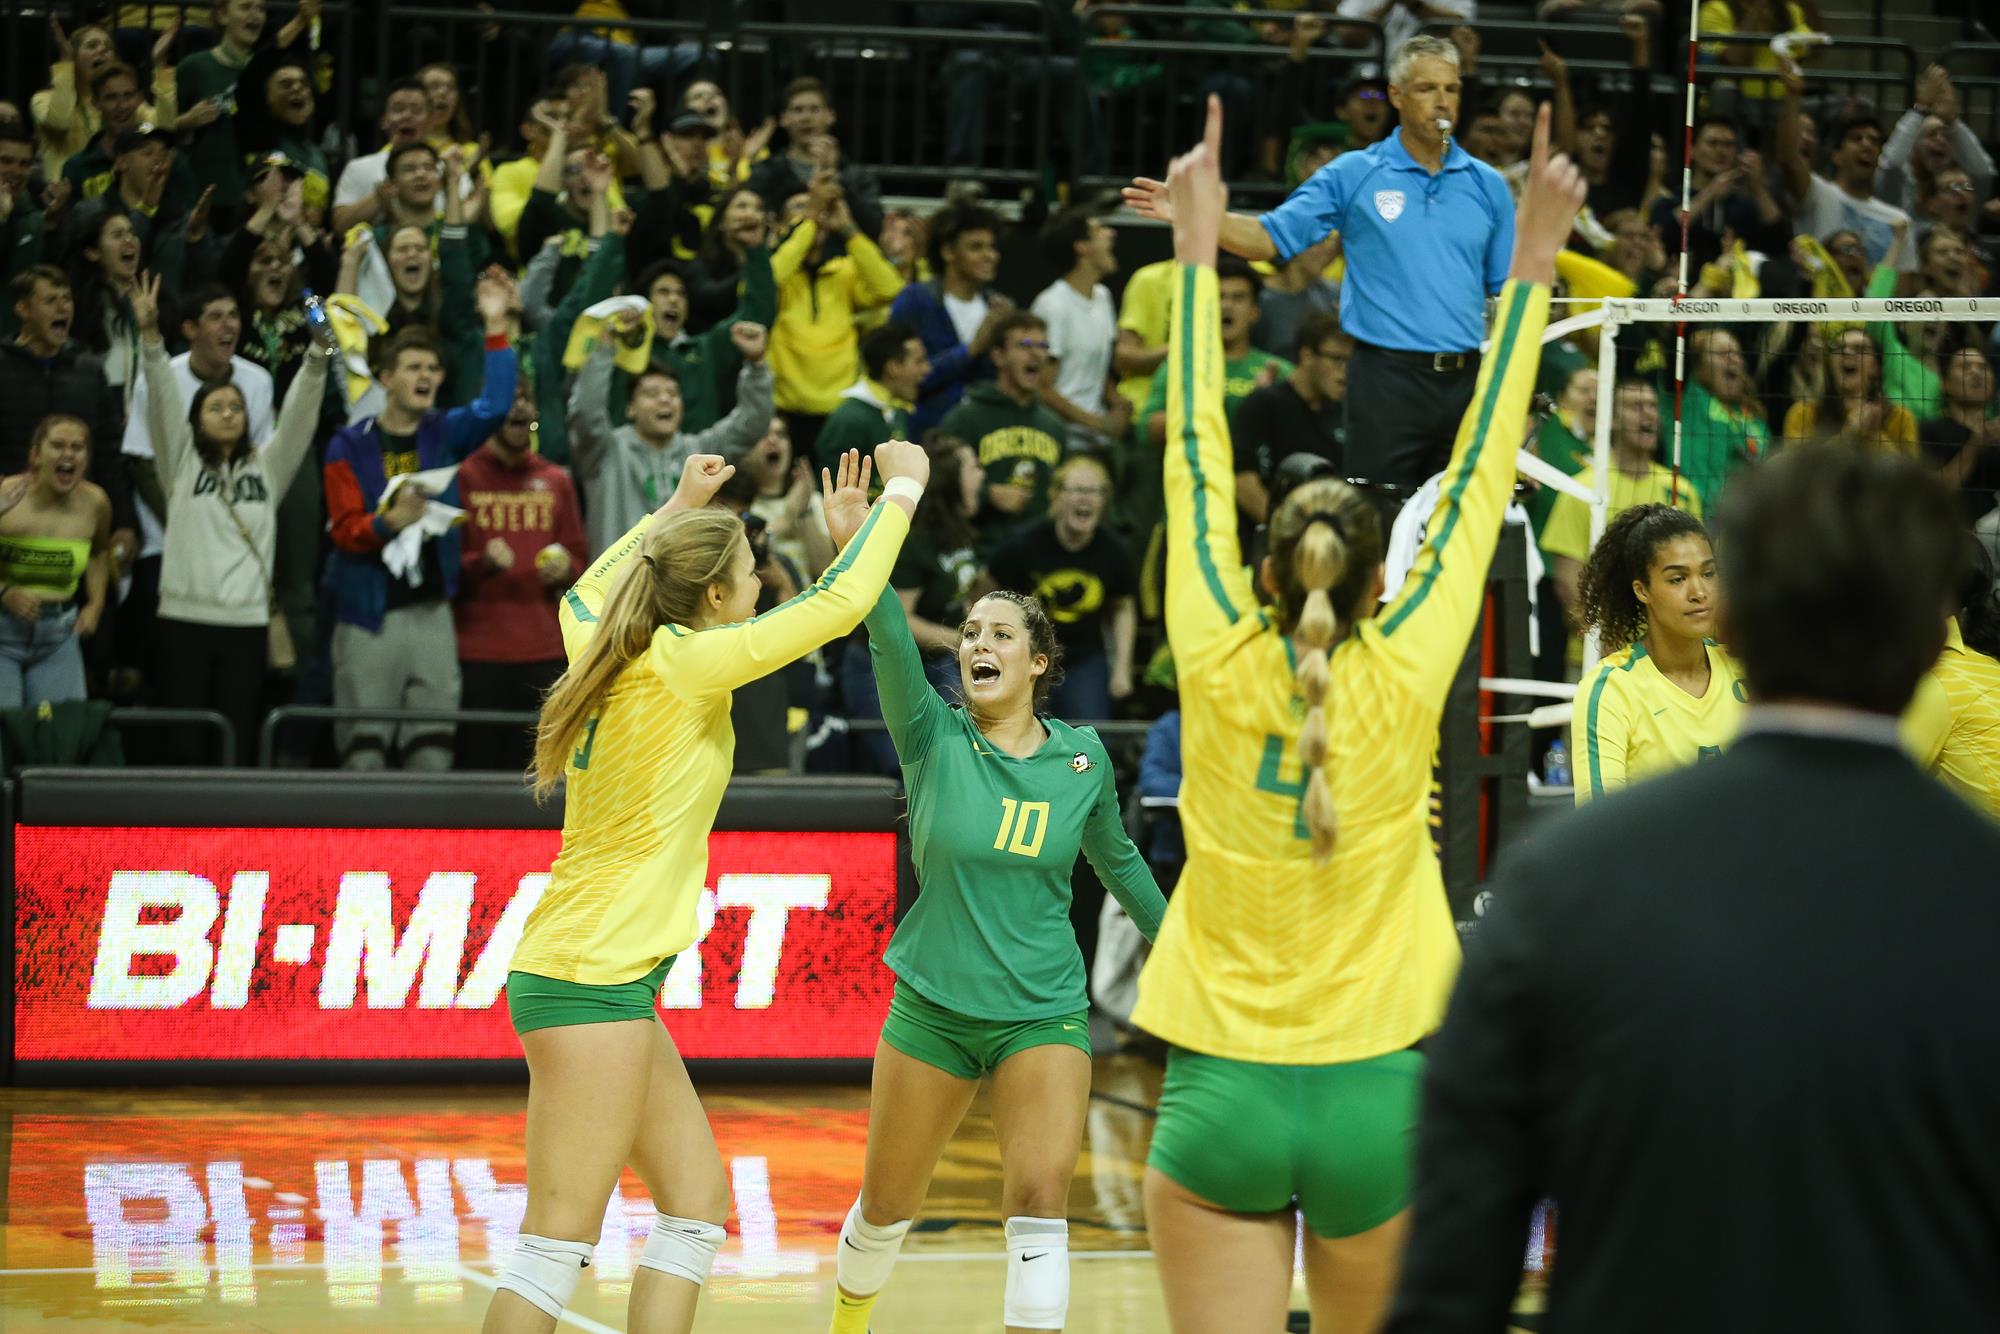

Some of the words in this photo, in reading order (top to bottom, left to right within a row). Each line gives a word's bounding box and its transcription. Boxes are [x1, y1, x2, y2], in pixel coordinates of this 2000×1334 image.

[1773, 302, 1828, 314] OREGON
[1885, 300, 1943, 312] OREGON
[594, 532, 644, 578] OREGON
[993, 796, 1050, 858] 10
